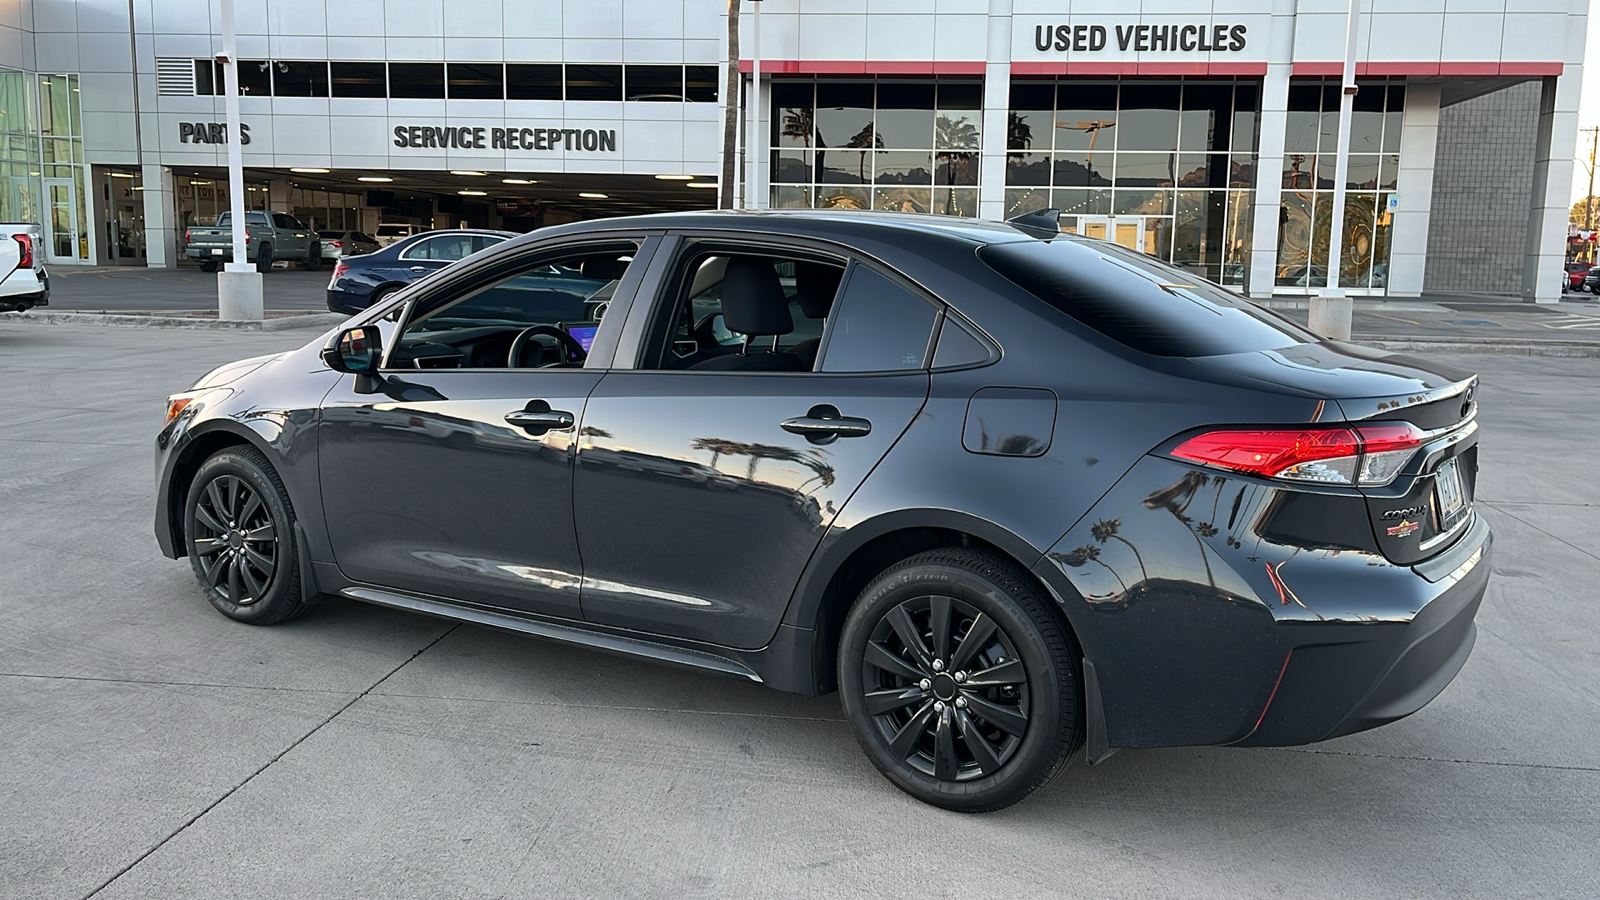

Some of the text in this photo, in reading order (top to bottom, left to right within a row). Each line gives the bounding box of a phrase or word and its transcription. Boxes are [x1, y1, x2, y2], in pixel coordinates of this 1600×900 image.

[1035, 25, 1247, 51] USED VEHICLES
[393, 125, 616, 152] SERVICE RECEPTION
